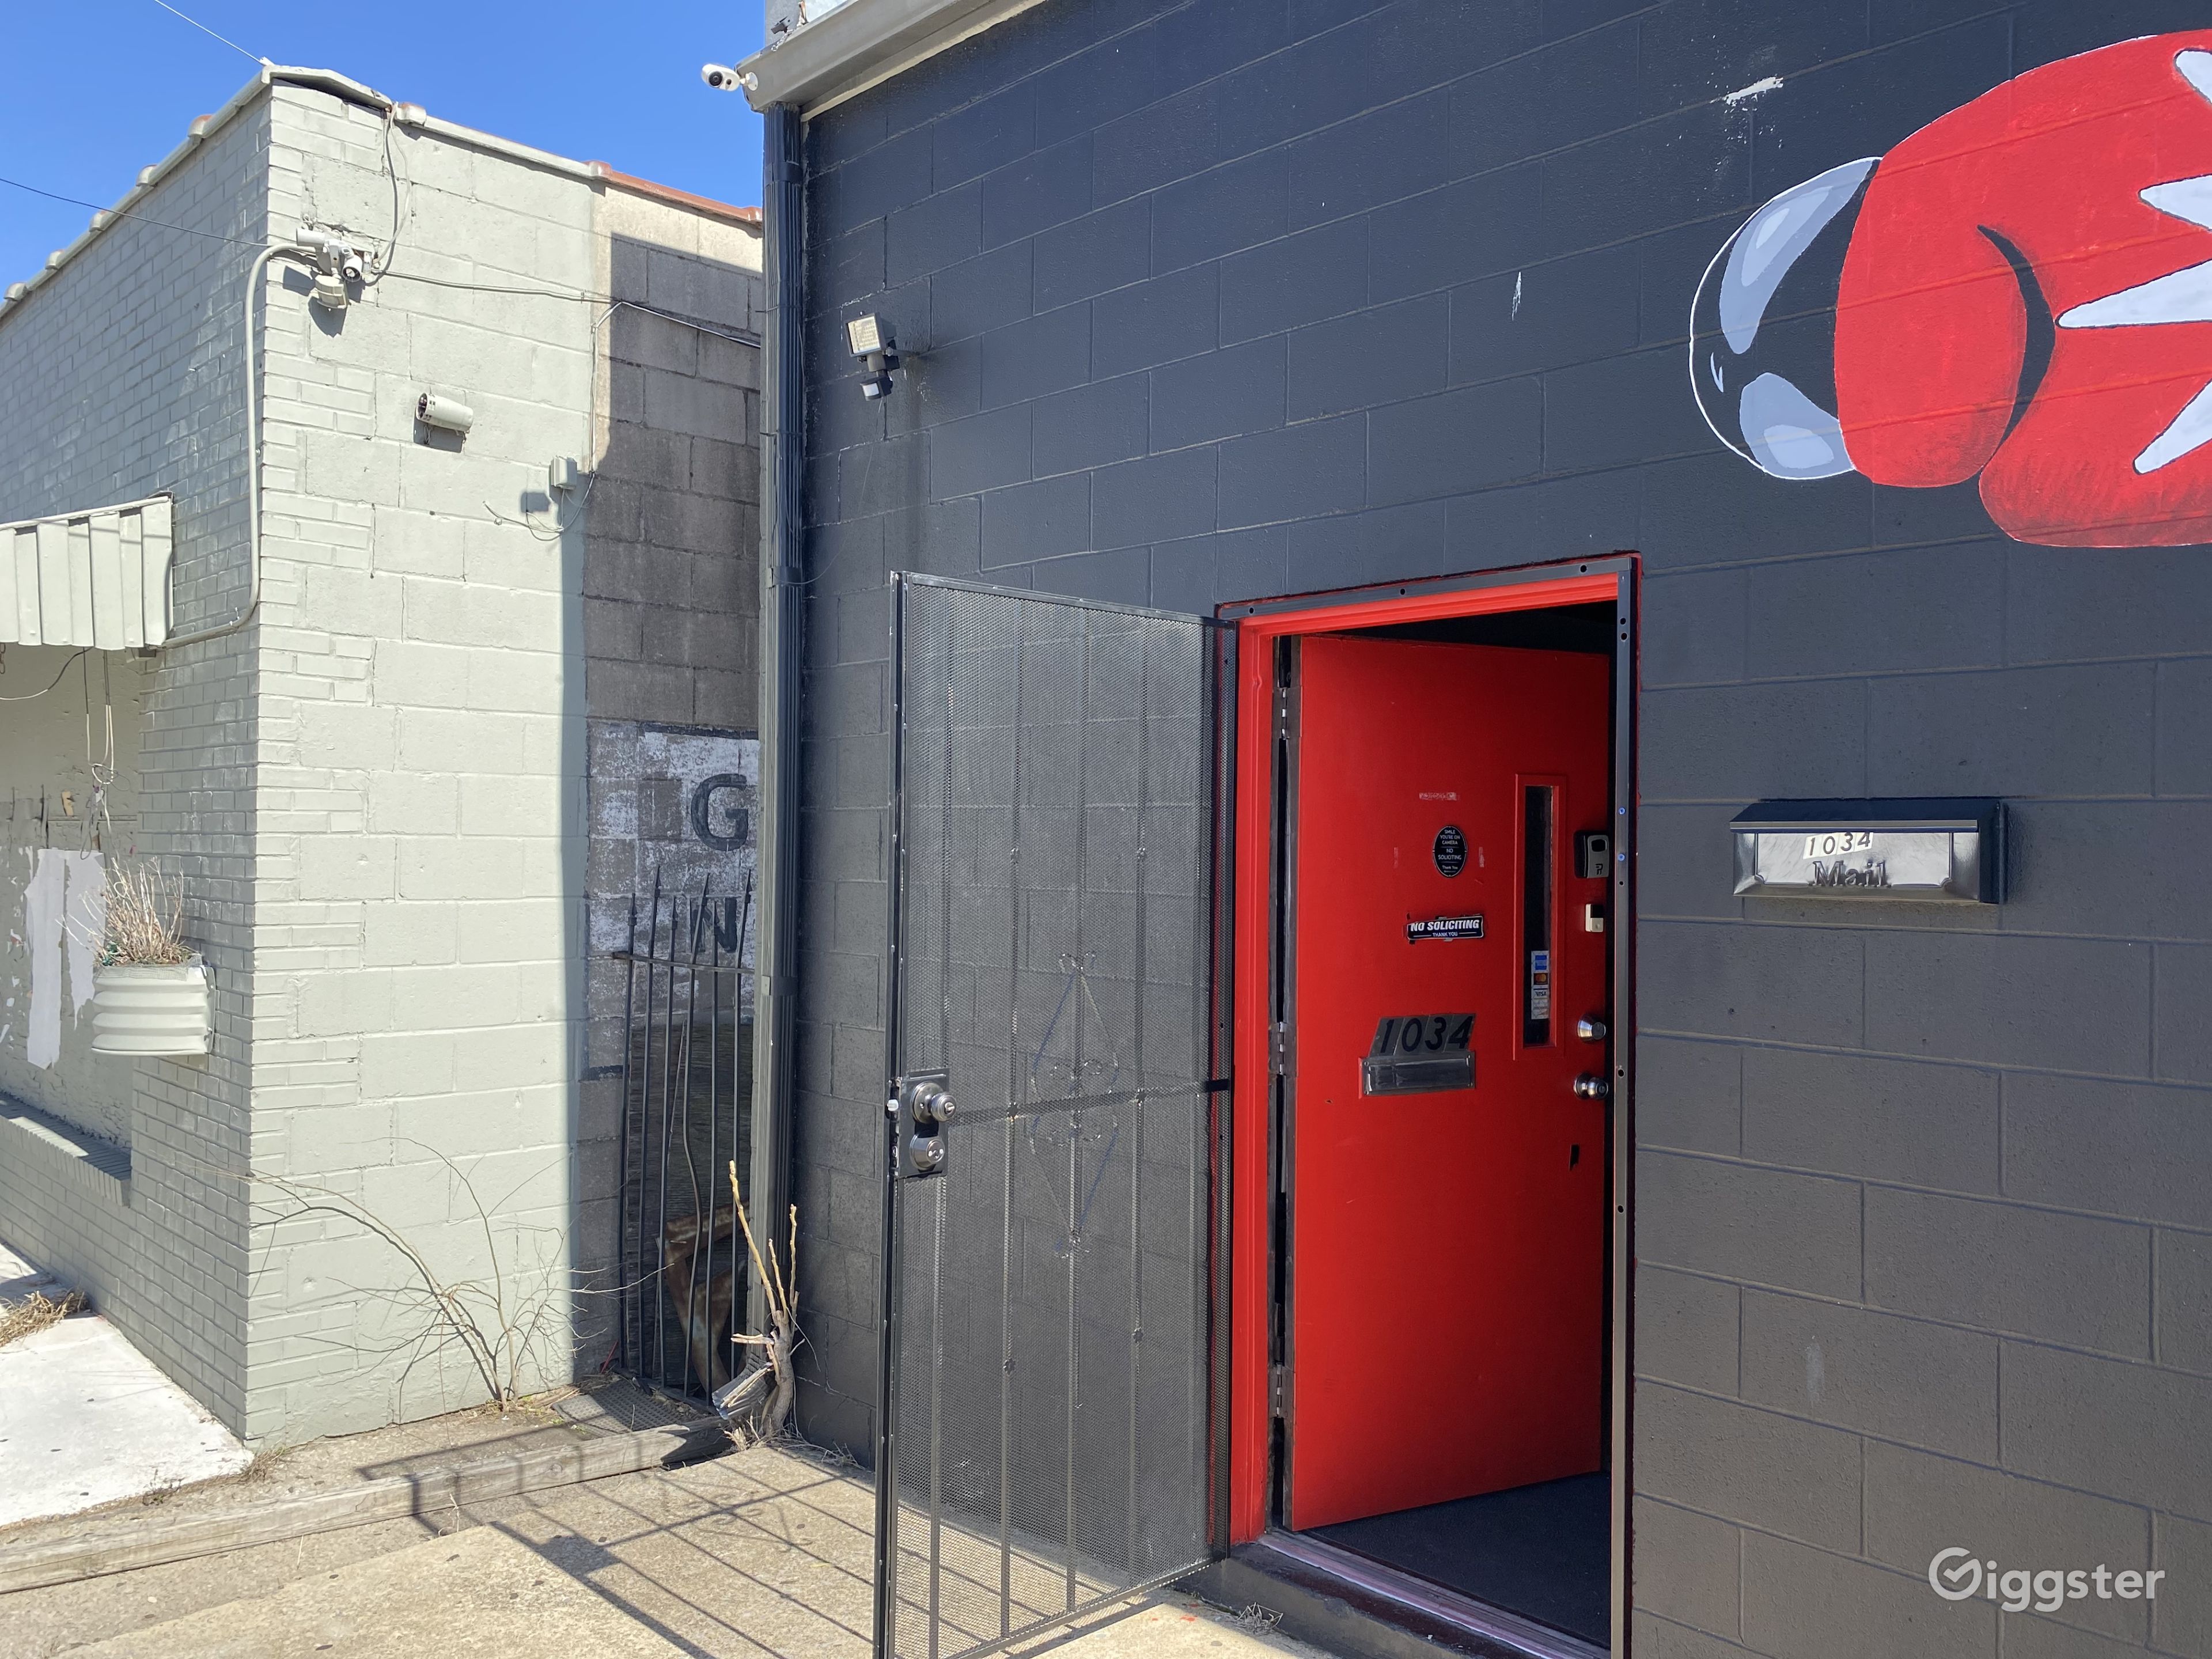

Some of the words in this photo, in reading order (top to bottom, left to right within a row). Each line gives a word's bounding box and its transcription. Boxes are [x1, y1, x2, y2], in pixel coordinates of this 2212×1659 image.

[1809, 832, 1870, 856] 1034
[1812, 860, 1890, 887] Mail
[1410, 922, 1425, 931] NO
[1427, 919, 1480, 930] SOLICITING
[1380, 1016, 1474, 1054] 1034
